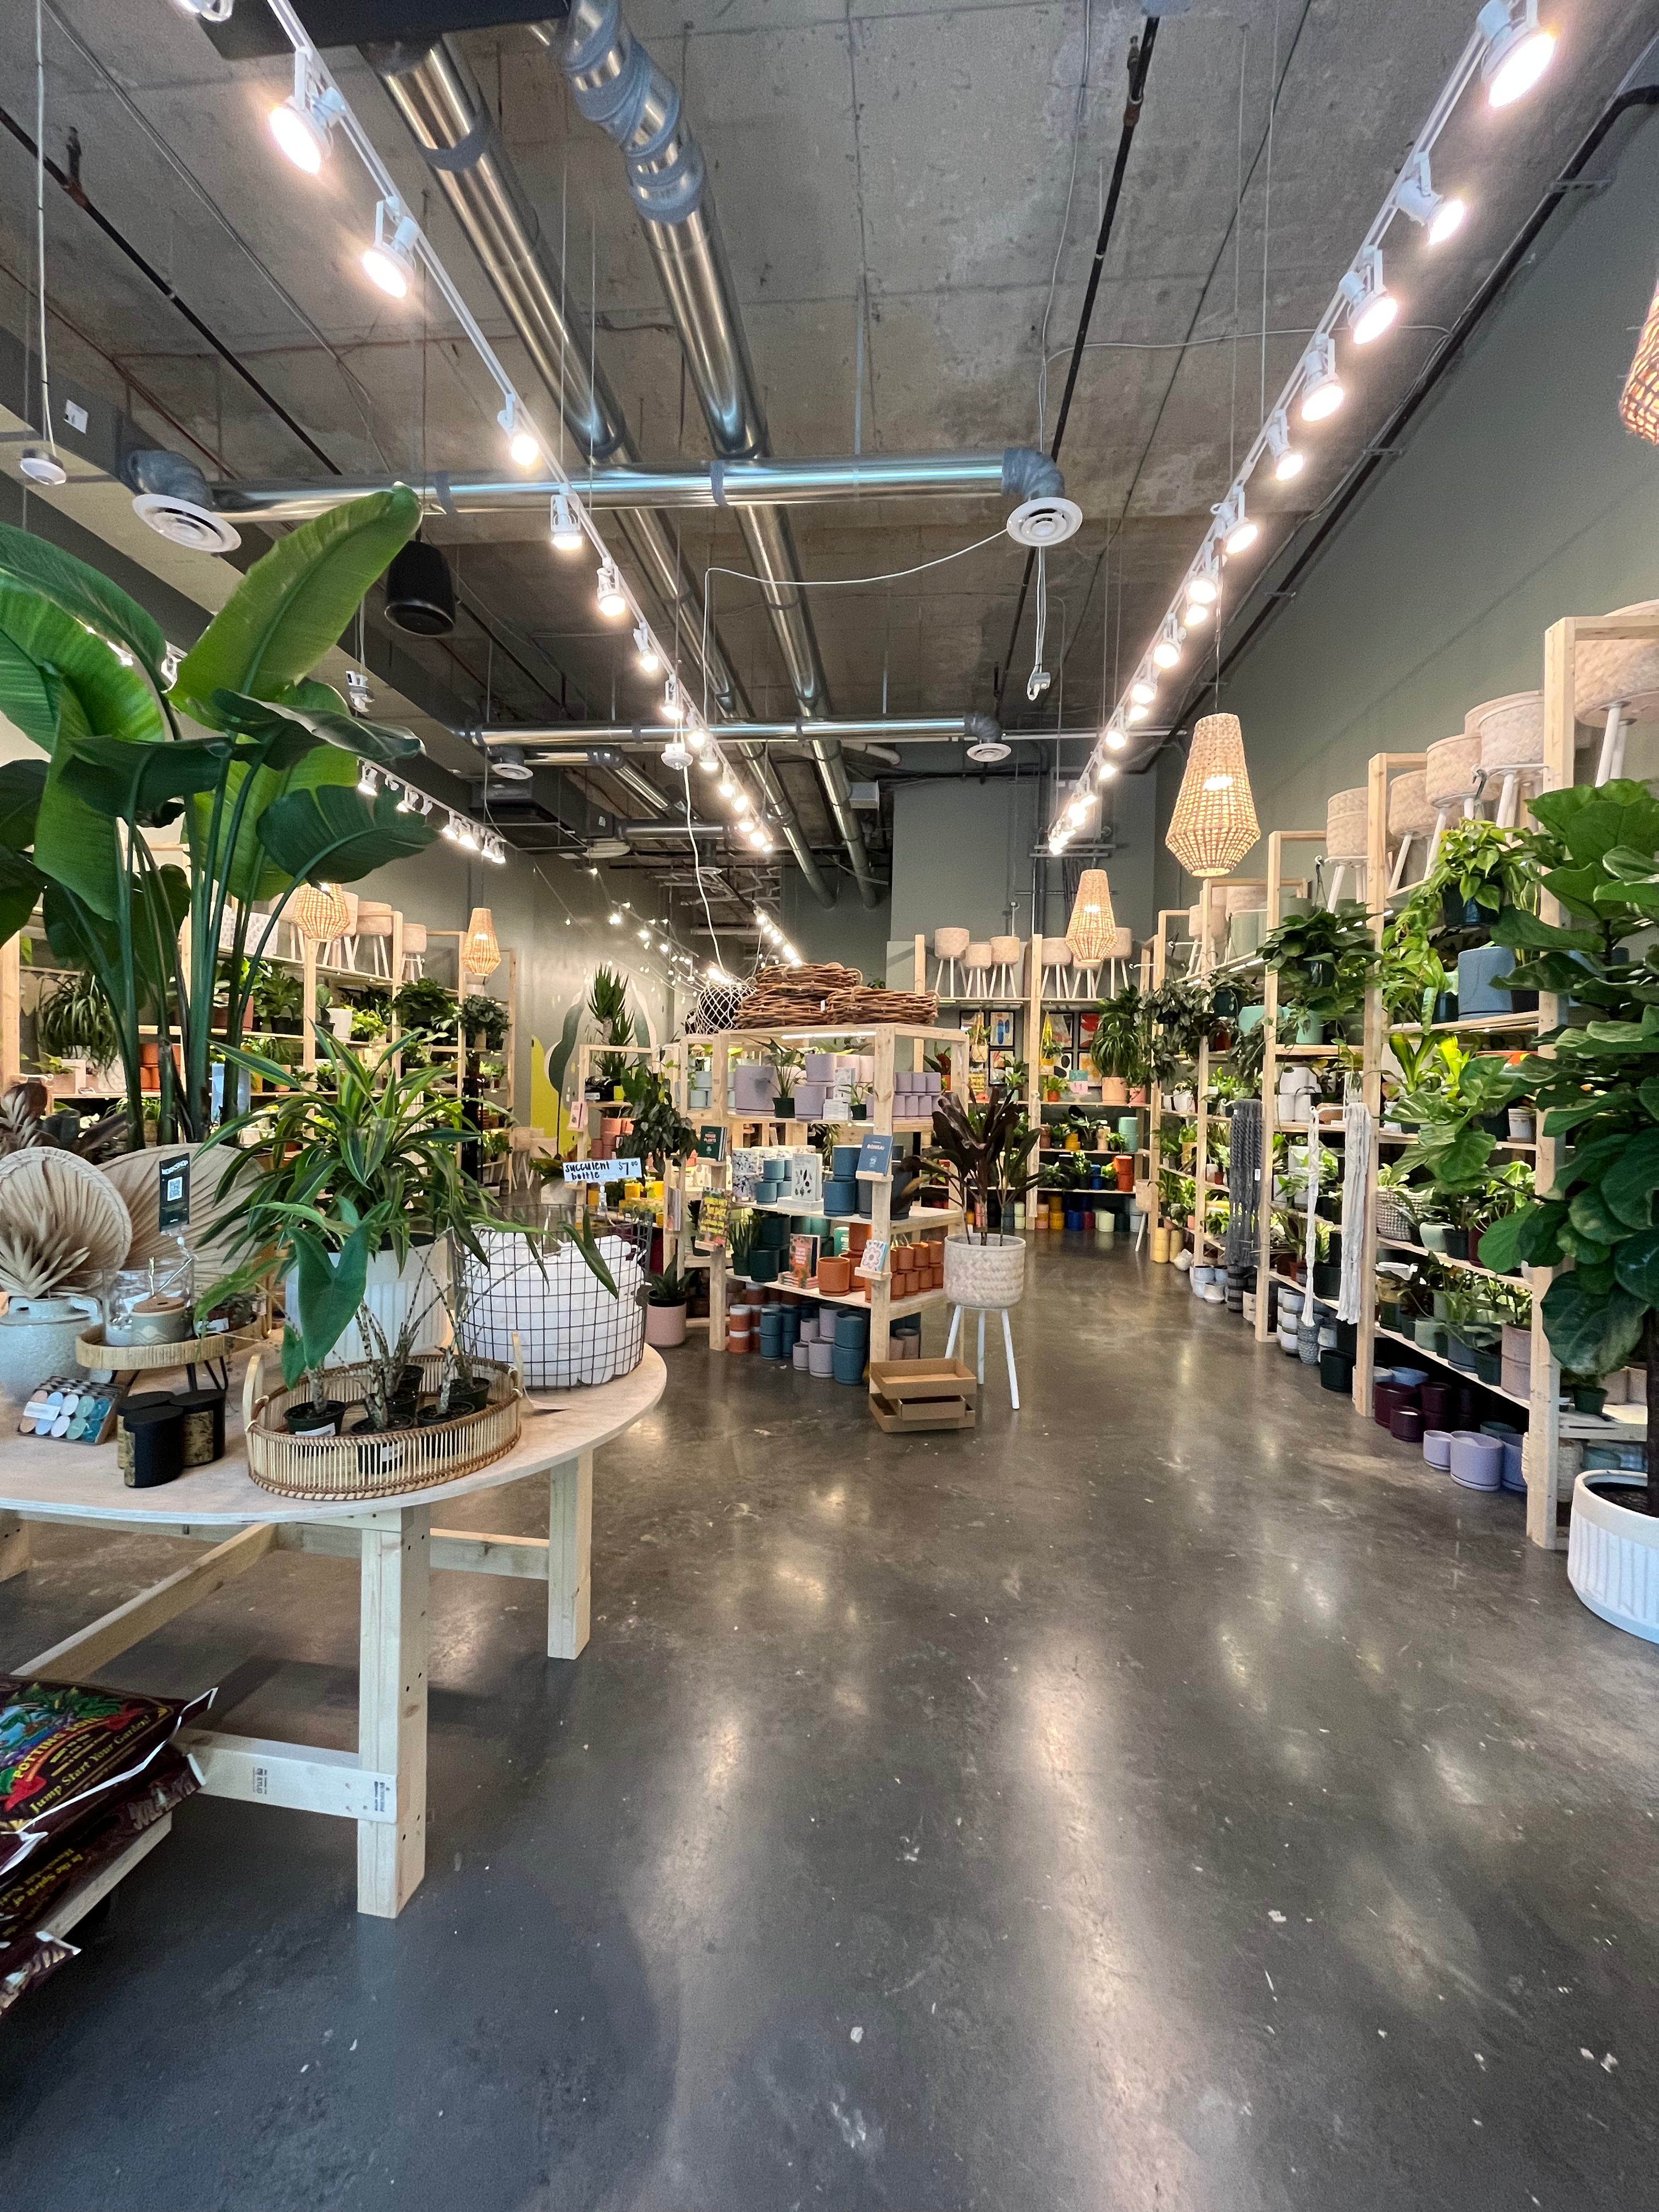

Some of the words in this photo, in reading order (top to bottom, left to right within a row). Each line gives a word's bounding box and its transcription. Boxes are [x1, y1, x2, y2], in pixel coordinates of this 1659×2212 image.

[565, 1161, 610, 1173] succulent
[572, 1171, 600, 1180] bottle
[13, 1732, 66, 1779] POTTING
[30, 1785, 63, 1814] Jump
[61, 1760, 91, 1785] Start
[88, 1742, 114, 1763] Your
[114, 1715, 151, 1745] Garden!
